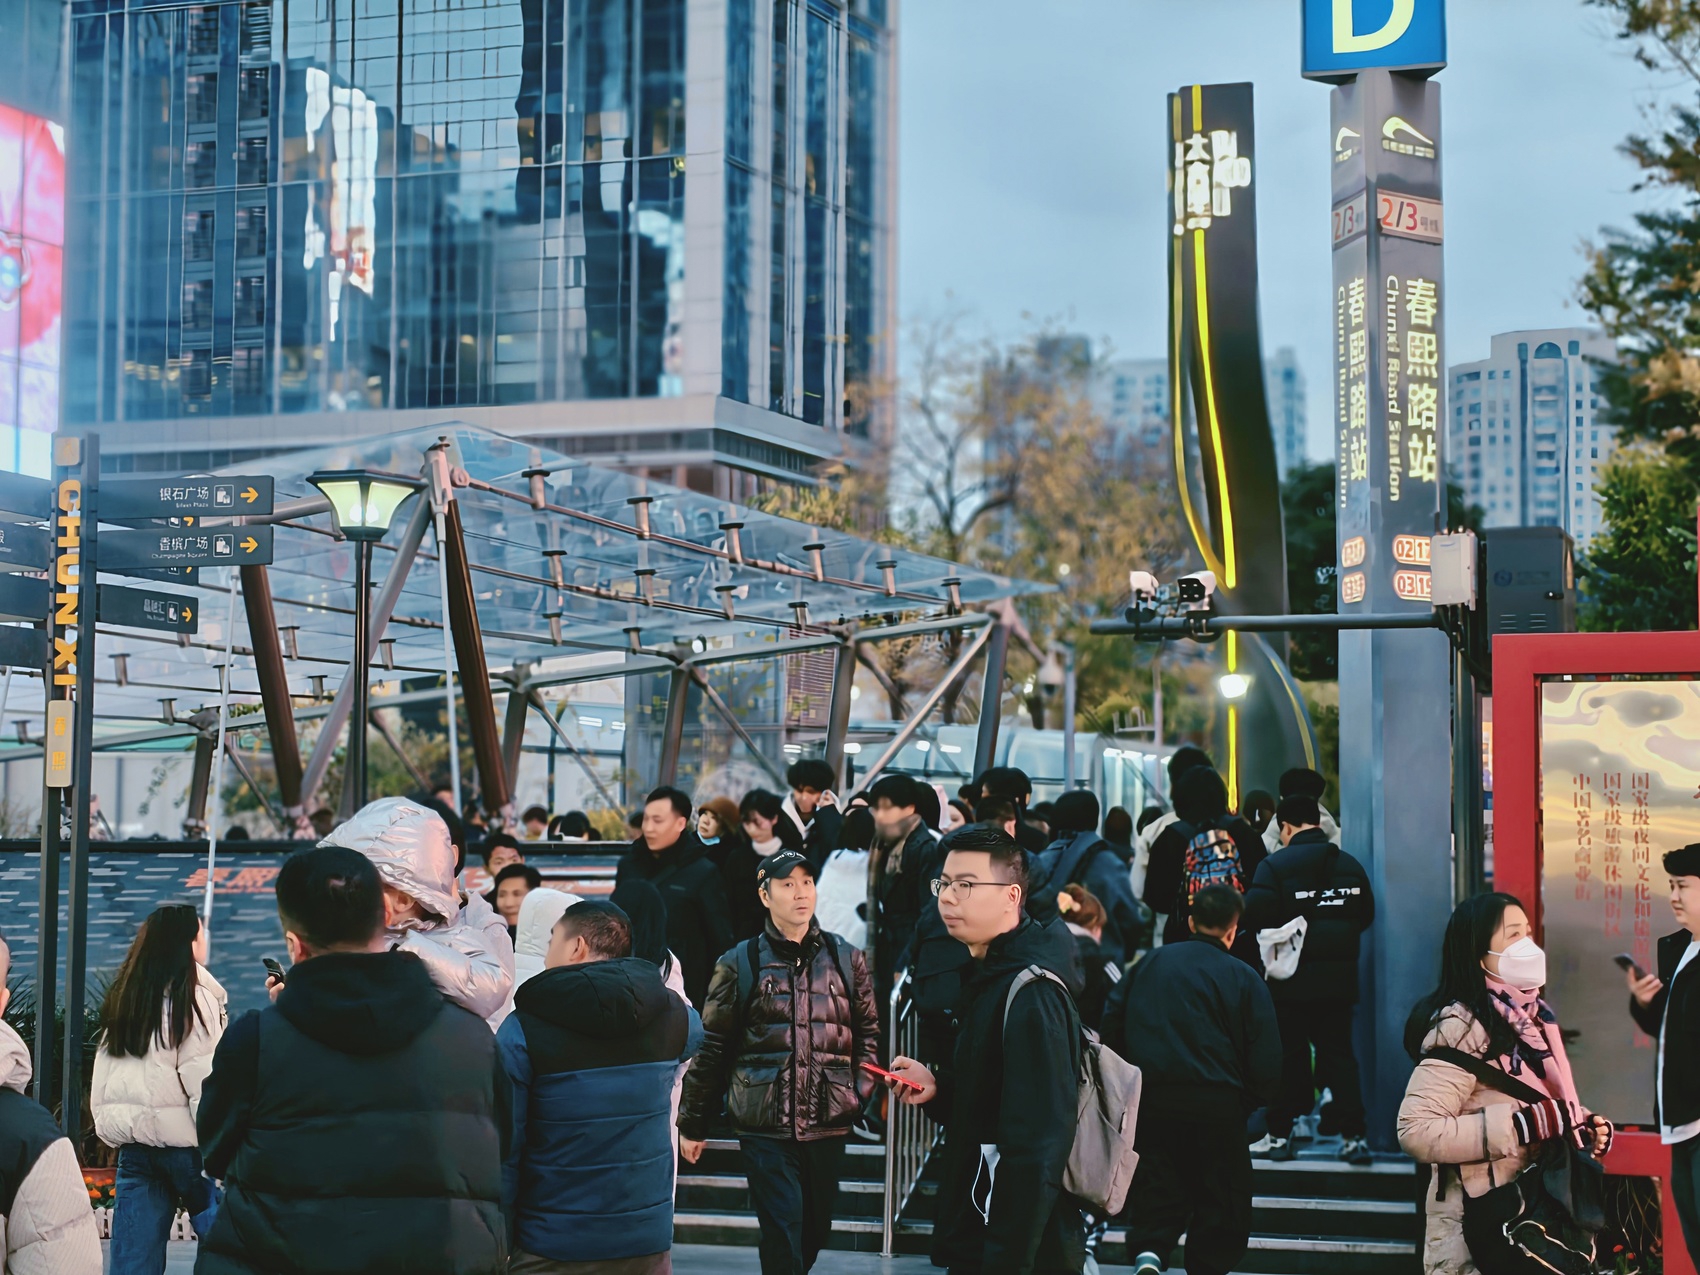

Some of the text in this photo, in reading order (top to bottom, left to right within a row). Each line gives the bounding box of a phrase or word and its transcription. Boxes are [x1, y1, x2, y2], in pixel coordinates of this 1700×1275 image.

[1332, 0, 1415, 54] D
[1348, 277, 1367, 482] 春熙路站
[1405, 278, 1438, 483] 春熙路站
[160, 486, 209, 501] 银石广场
[159, 536, 208, 551] 香槟广场
[1396, 539, 1414, 558] 02
[1397, 575, 1415, 594] 03
